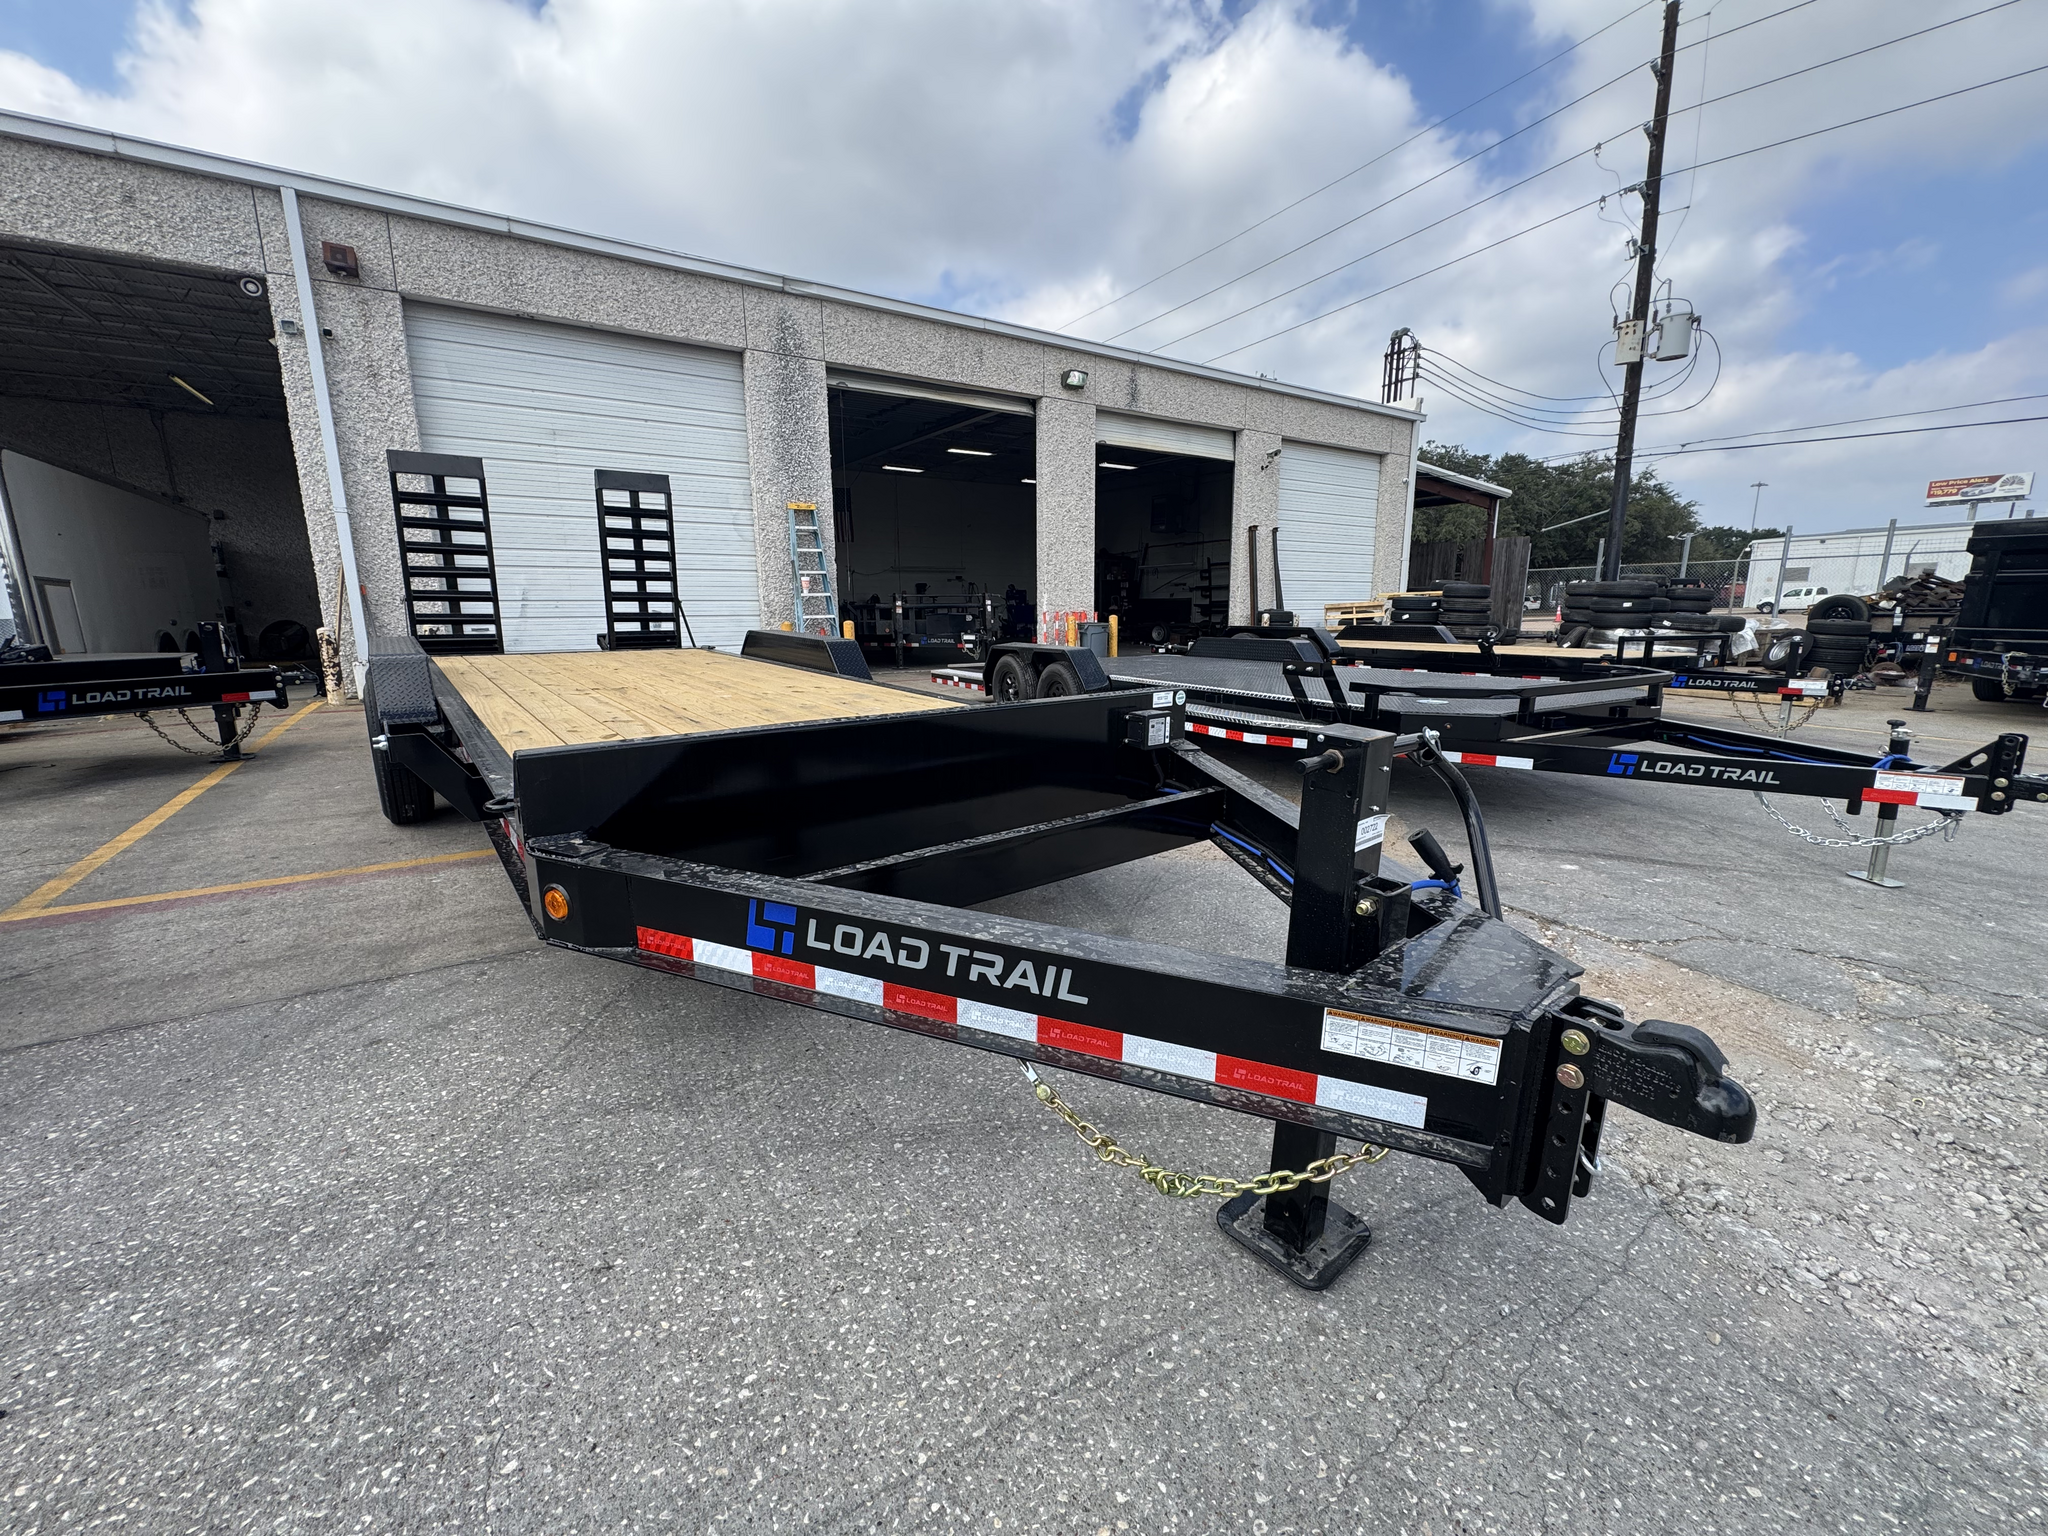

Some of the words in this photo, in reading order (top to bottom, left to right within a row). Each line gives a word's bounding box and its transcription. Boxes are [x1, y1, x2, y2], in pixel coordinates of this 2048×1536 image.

[1688, 678, 1722, 687] LOAD
[1723, 680, 1758, 689] TRAIL
[72, 690, 131, 705] LOAD
[134, 685, 192, 699] TRAIL
[1640, 760, 1705, 778] LOAD
[1710, 764, 1780, 785] TRAIL
[806, 918, 930, 970] LOAD
[940, 944, 1089, 1005] TRAIL
[773, 967, 790, 976] LOAD
[791, 970, 809, 979] TRAIL
[906, 996, 926, 1006] LOAD
[927, 1000, 948, 1012] TRAIL
[1332, 1010, 1359, 1020] WARNING
[1365, 1017, 1393, 1027] WARNING
[1399, 1023, 1427, 1033] WARNING
[1061, 1033, 1085, 1043] LOAD
[1086, 1037, 1110, 1048] TRAIL
[1434, 1030, 1463, 1040] WARNING
[1470, 1036, 1500, 1047] WARNING
[1248, 1073, 1275, 1086] LOAD
[1275, 1078, 1305, 1091] TRAIL
